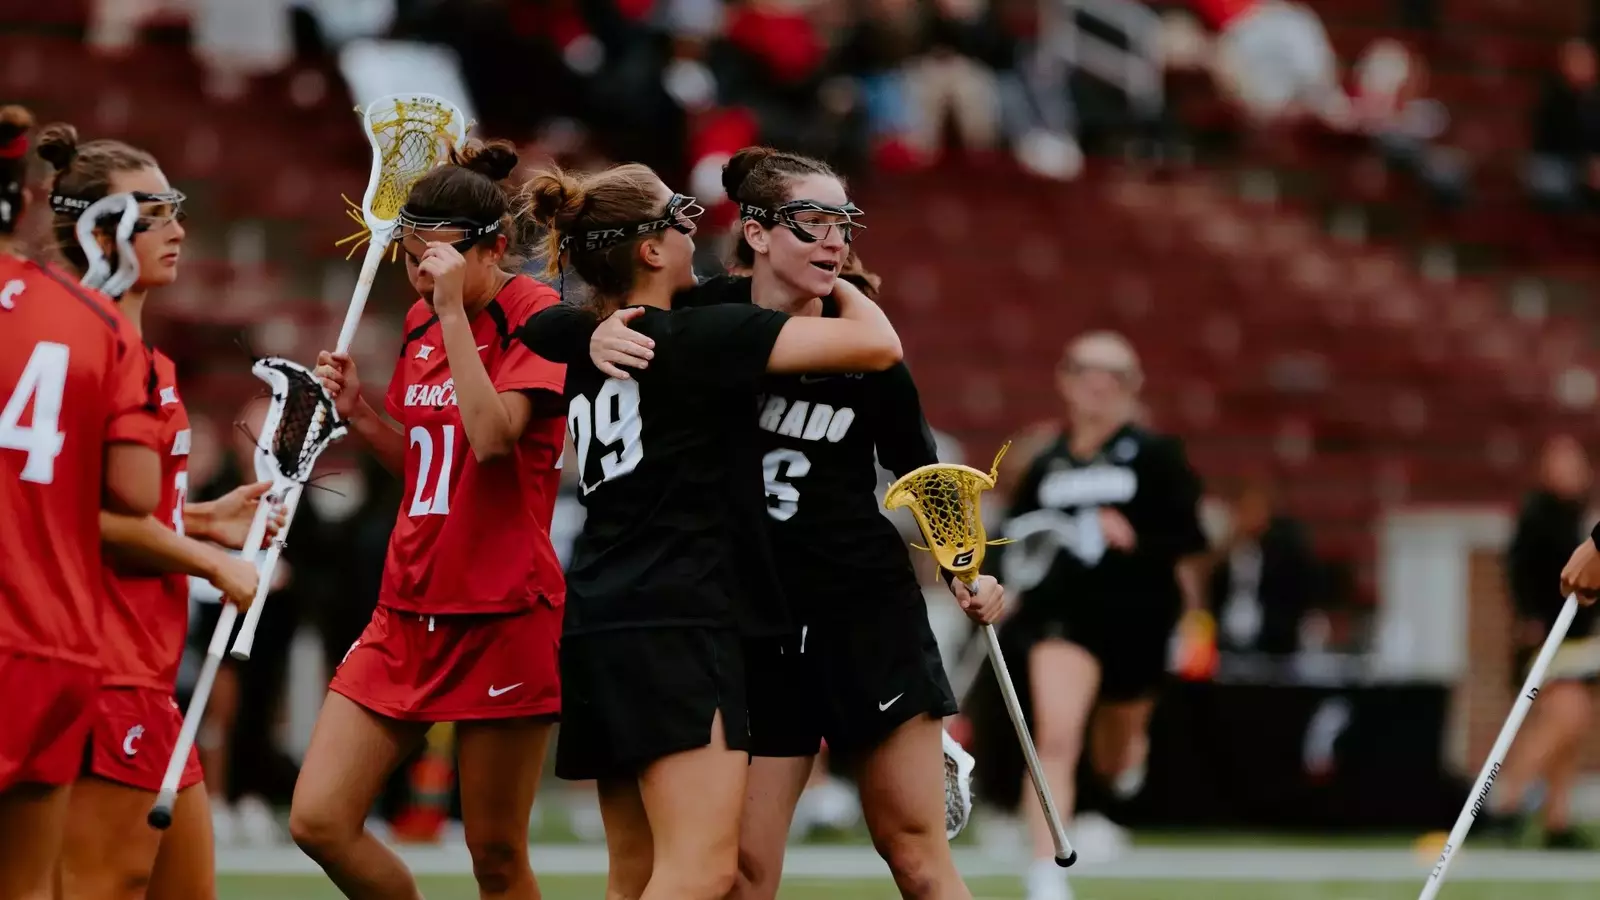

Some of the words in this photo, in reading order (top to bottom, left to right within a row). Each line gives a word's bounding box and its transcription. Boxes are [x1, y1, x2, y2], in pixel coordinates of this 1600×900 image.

[420, 96, 436, 106] STX
[637, 217, 672, 234] STX
[747, 205, 767, 218] STX
[586, 227, 625, 240] STX
[0, 341, 70, 484] 4
[757, 394, 855, 443] RADO
[567, 377, 644, 496] 29
[408, 425, 455, 517] 21
[762, 448, 812, 521] 6
[952, 549, 975, 567] G
